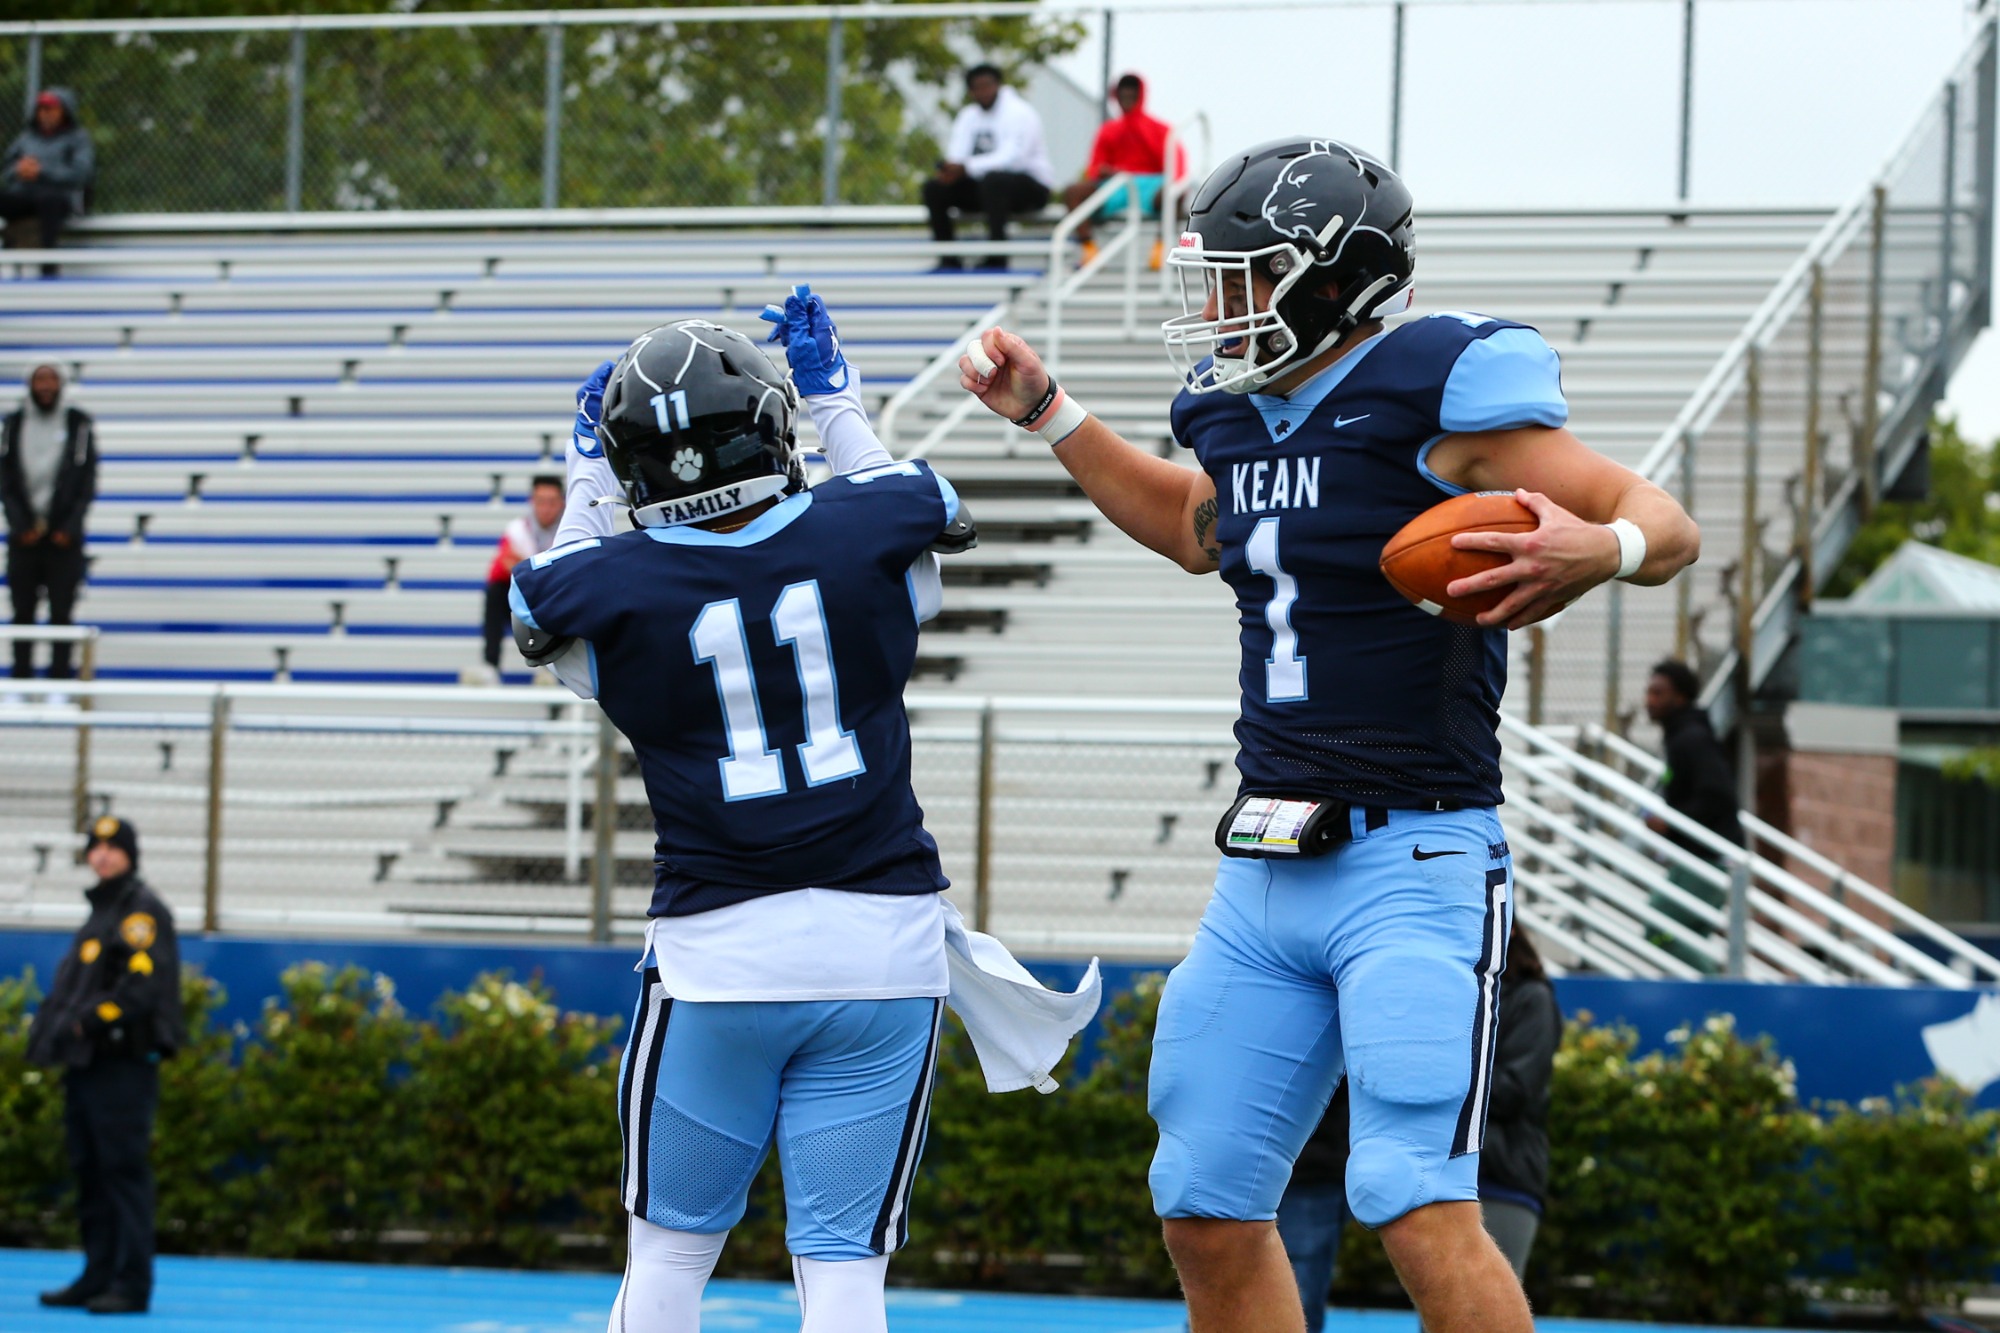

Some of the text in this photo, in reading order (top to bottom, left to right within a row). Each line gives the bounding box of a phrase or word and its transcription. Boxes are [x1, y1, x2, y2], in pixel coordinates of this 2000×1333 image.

[650, 389, 690, 434] 11
[660, 487, 742, 525] FAMILY
[1232, 456, 1321, 515] KEAN
[1245, 516, 1309, 703] 1
[688, 578, 867, 802] 11
